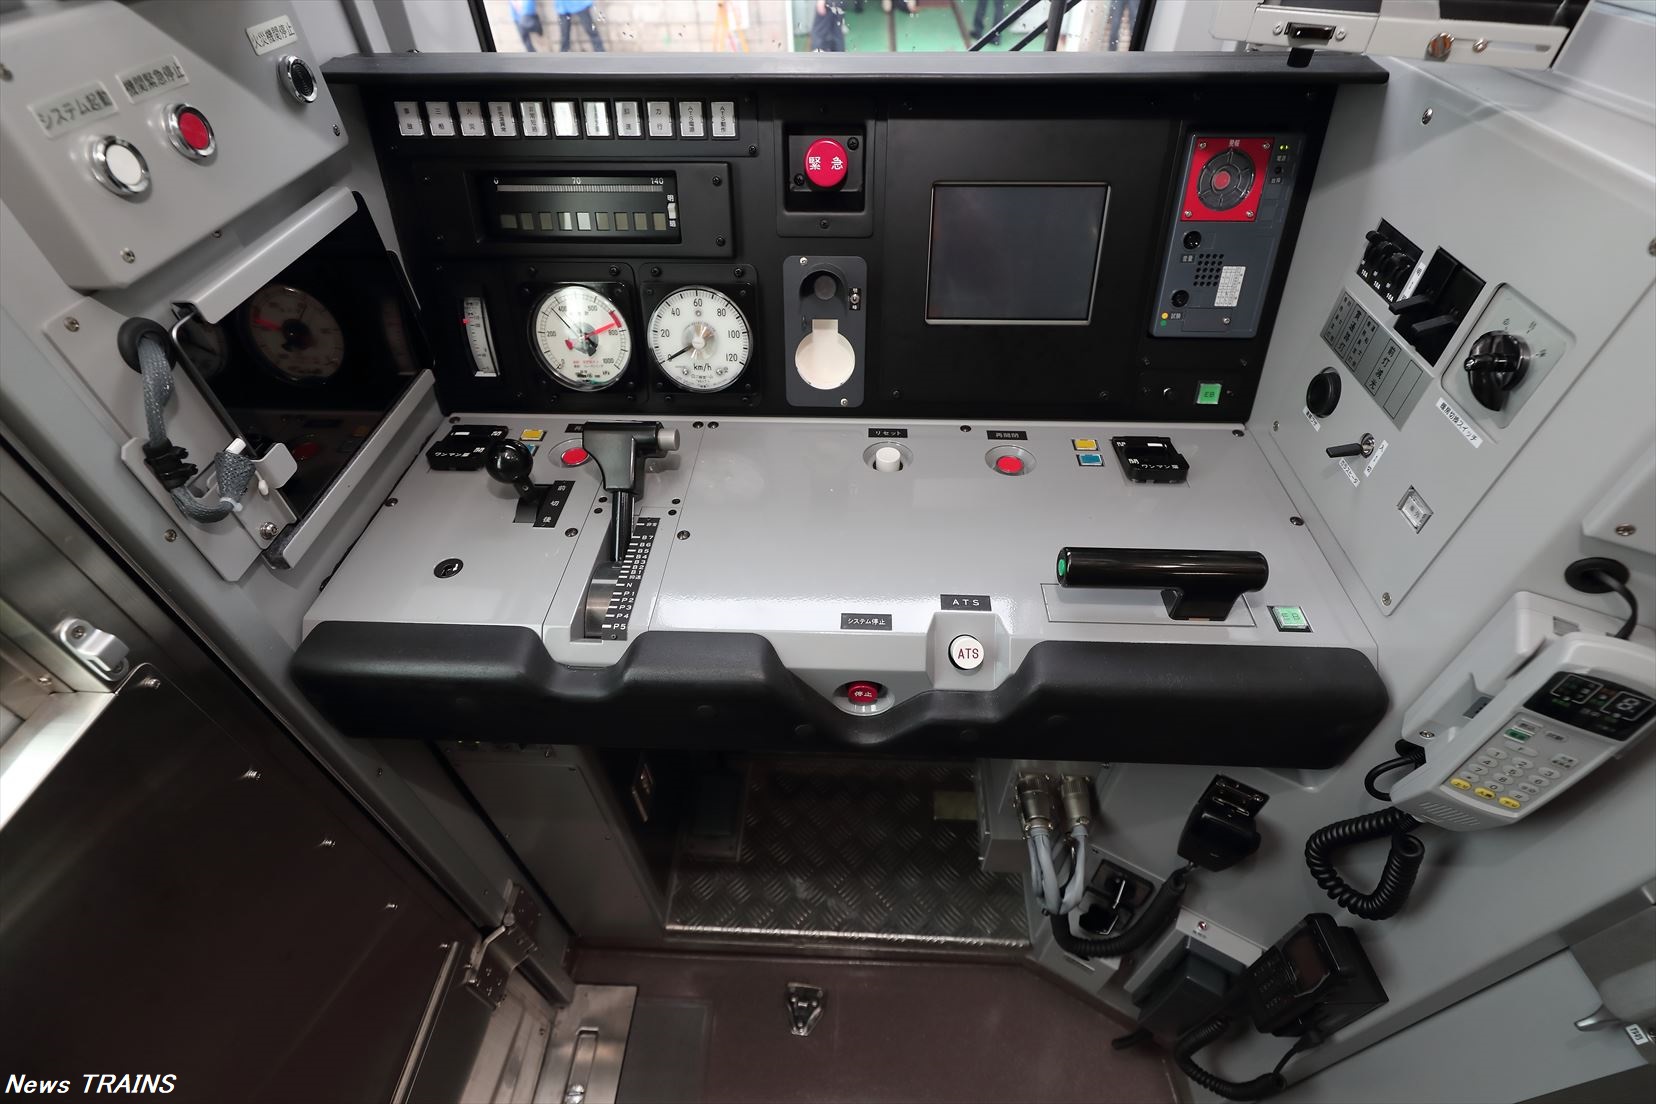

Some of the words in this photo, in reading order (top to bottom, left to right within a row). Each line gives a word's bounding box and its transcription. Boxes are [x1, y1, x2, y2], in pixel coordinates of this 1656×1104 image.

[122, 63, 186, 97] 機関緊急停止
[37, 87, 114, 131] システム起動
[808, 156, 844, 170] 緊急
[571, 177, 582, 185] 70
[650, 177, 664, 185] 140
[693, 298, 703, 307] 60
[670, 307, 681, 316] 40
[716, 308, 727, 317] 80
[660, 329, 670, 338] 20
[727, 330, 741, 339] 100
[726, 353, 738, 362] 120
[693, 362, 712, 372] km/h
[875, 429, 902, 437] リセット
[952, 598, 980, 606] ATS
[847, 618, 886, 626] システム停止
[957, 648, 979, 660] ATS
[853, 690, 873, 698] 停止
